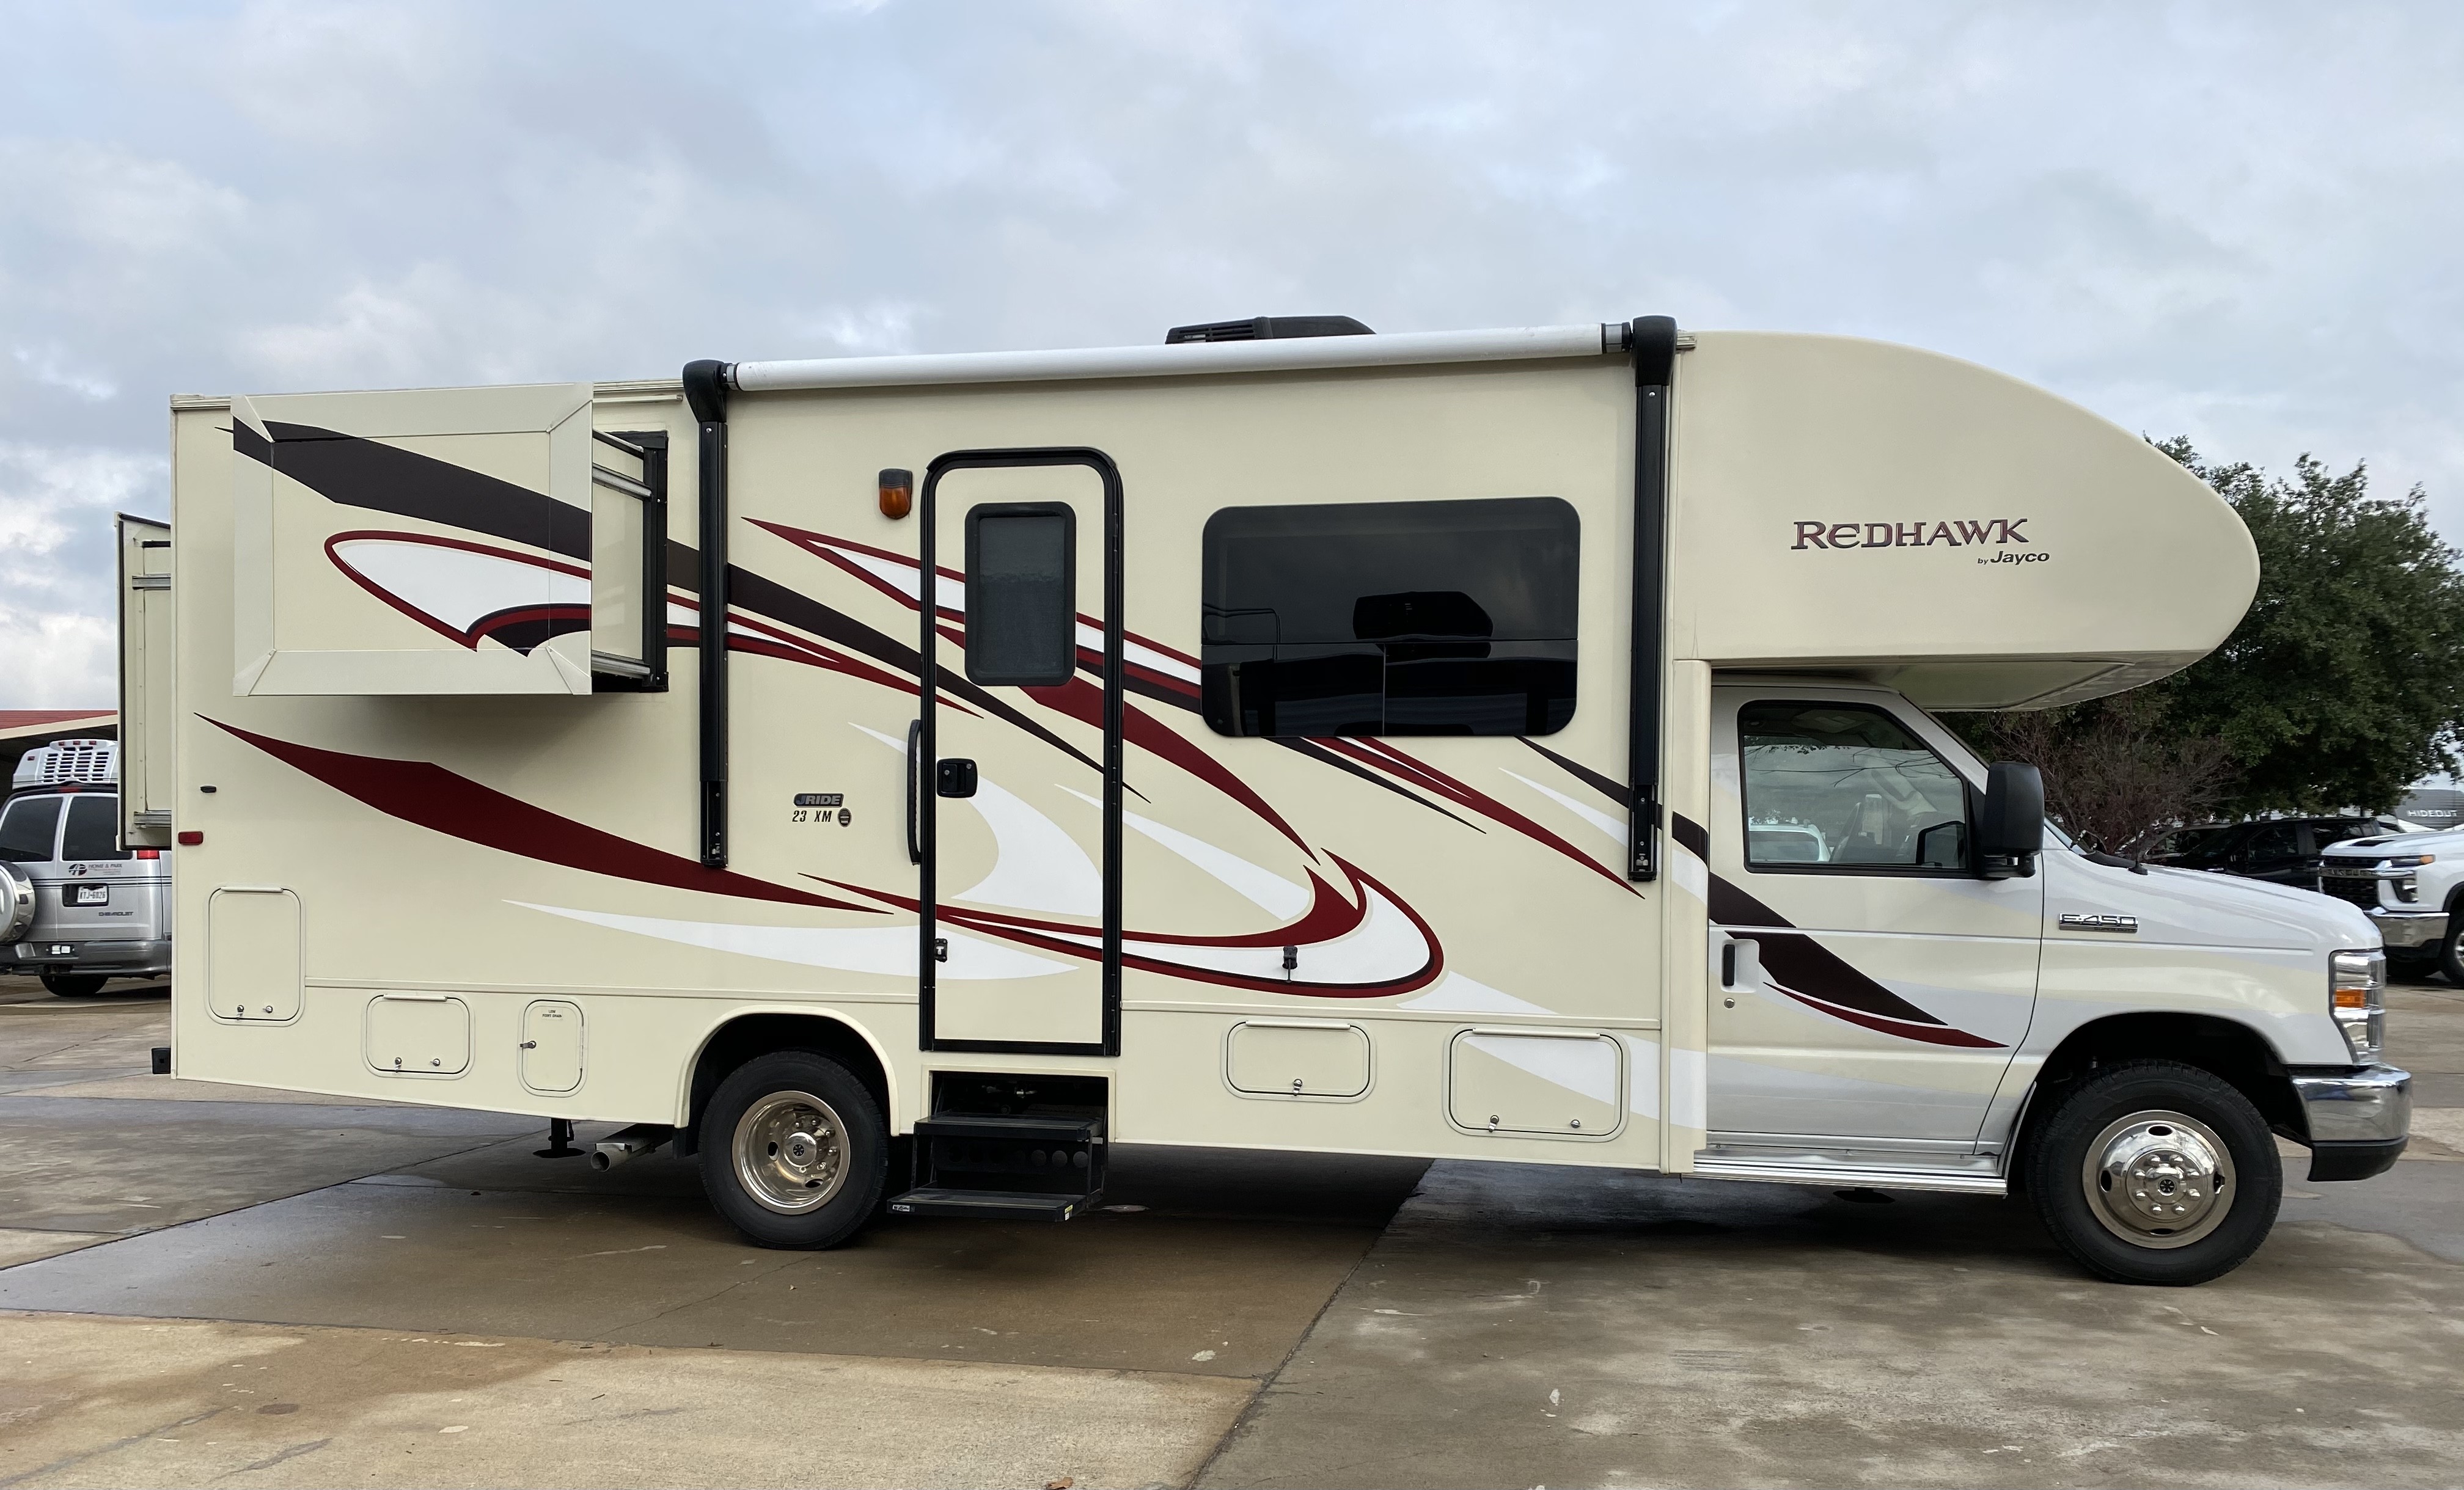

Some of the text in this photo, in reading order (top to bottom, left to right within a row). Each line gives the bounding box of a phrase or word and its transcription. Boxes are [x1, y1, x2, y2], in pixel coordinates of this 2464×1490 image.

[1791, 518, 2030, 550] REDHAWK
[1990, 550, 2050, 565] Jayco
[796, 795, 842, 805] JRIDE
[792, 810, 832, 822] 23 XM
